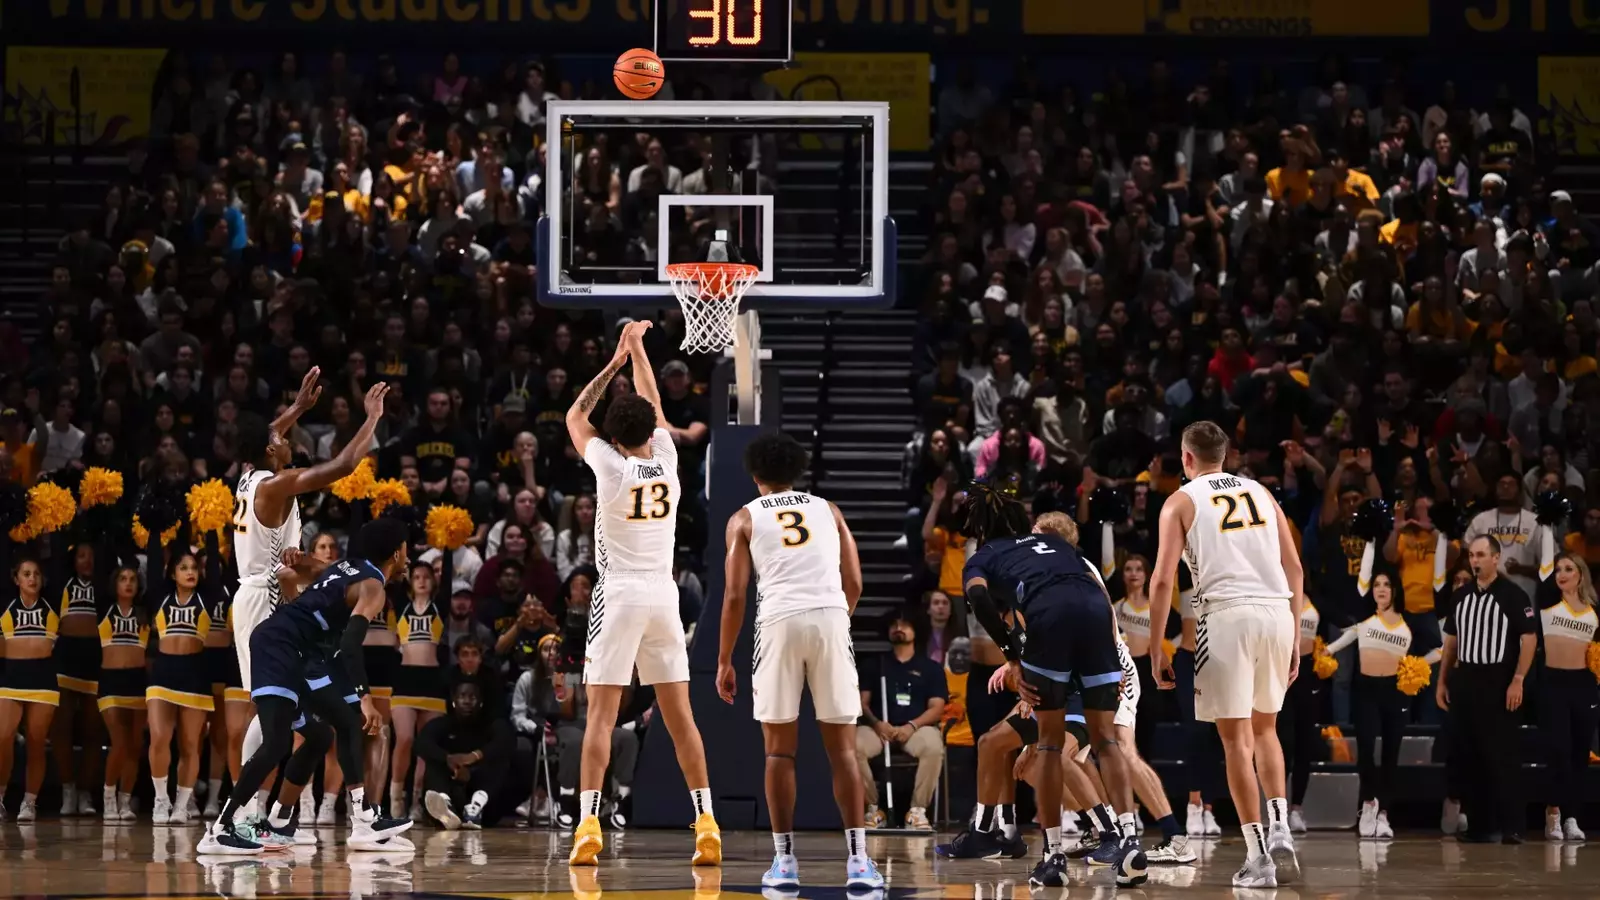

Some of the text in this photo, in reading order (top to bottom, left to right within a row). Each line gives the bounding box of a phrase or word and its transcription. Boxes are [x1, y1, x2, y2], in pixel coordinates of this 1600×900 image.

[687, 0, 762, 45] 30
[1208, 477, 1242, 491] OKROS
[628, 482, 670, 520] 13
[760, 494, 811, 509] BERGENS
[1212, 492, 1266, 531] 21
[777, 510, 810, 547] 3
[1031, 541, 1057, 555] 2
[1551, 615, 1594, 635] DRAGONS
